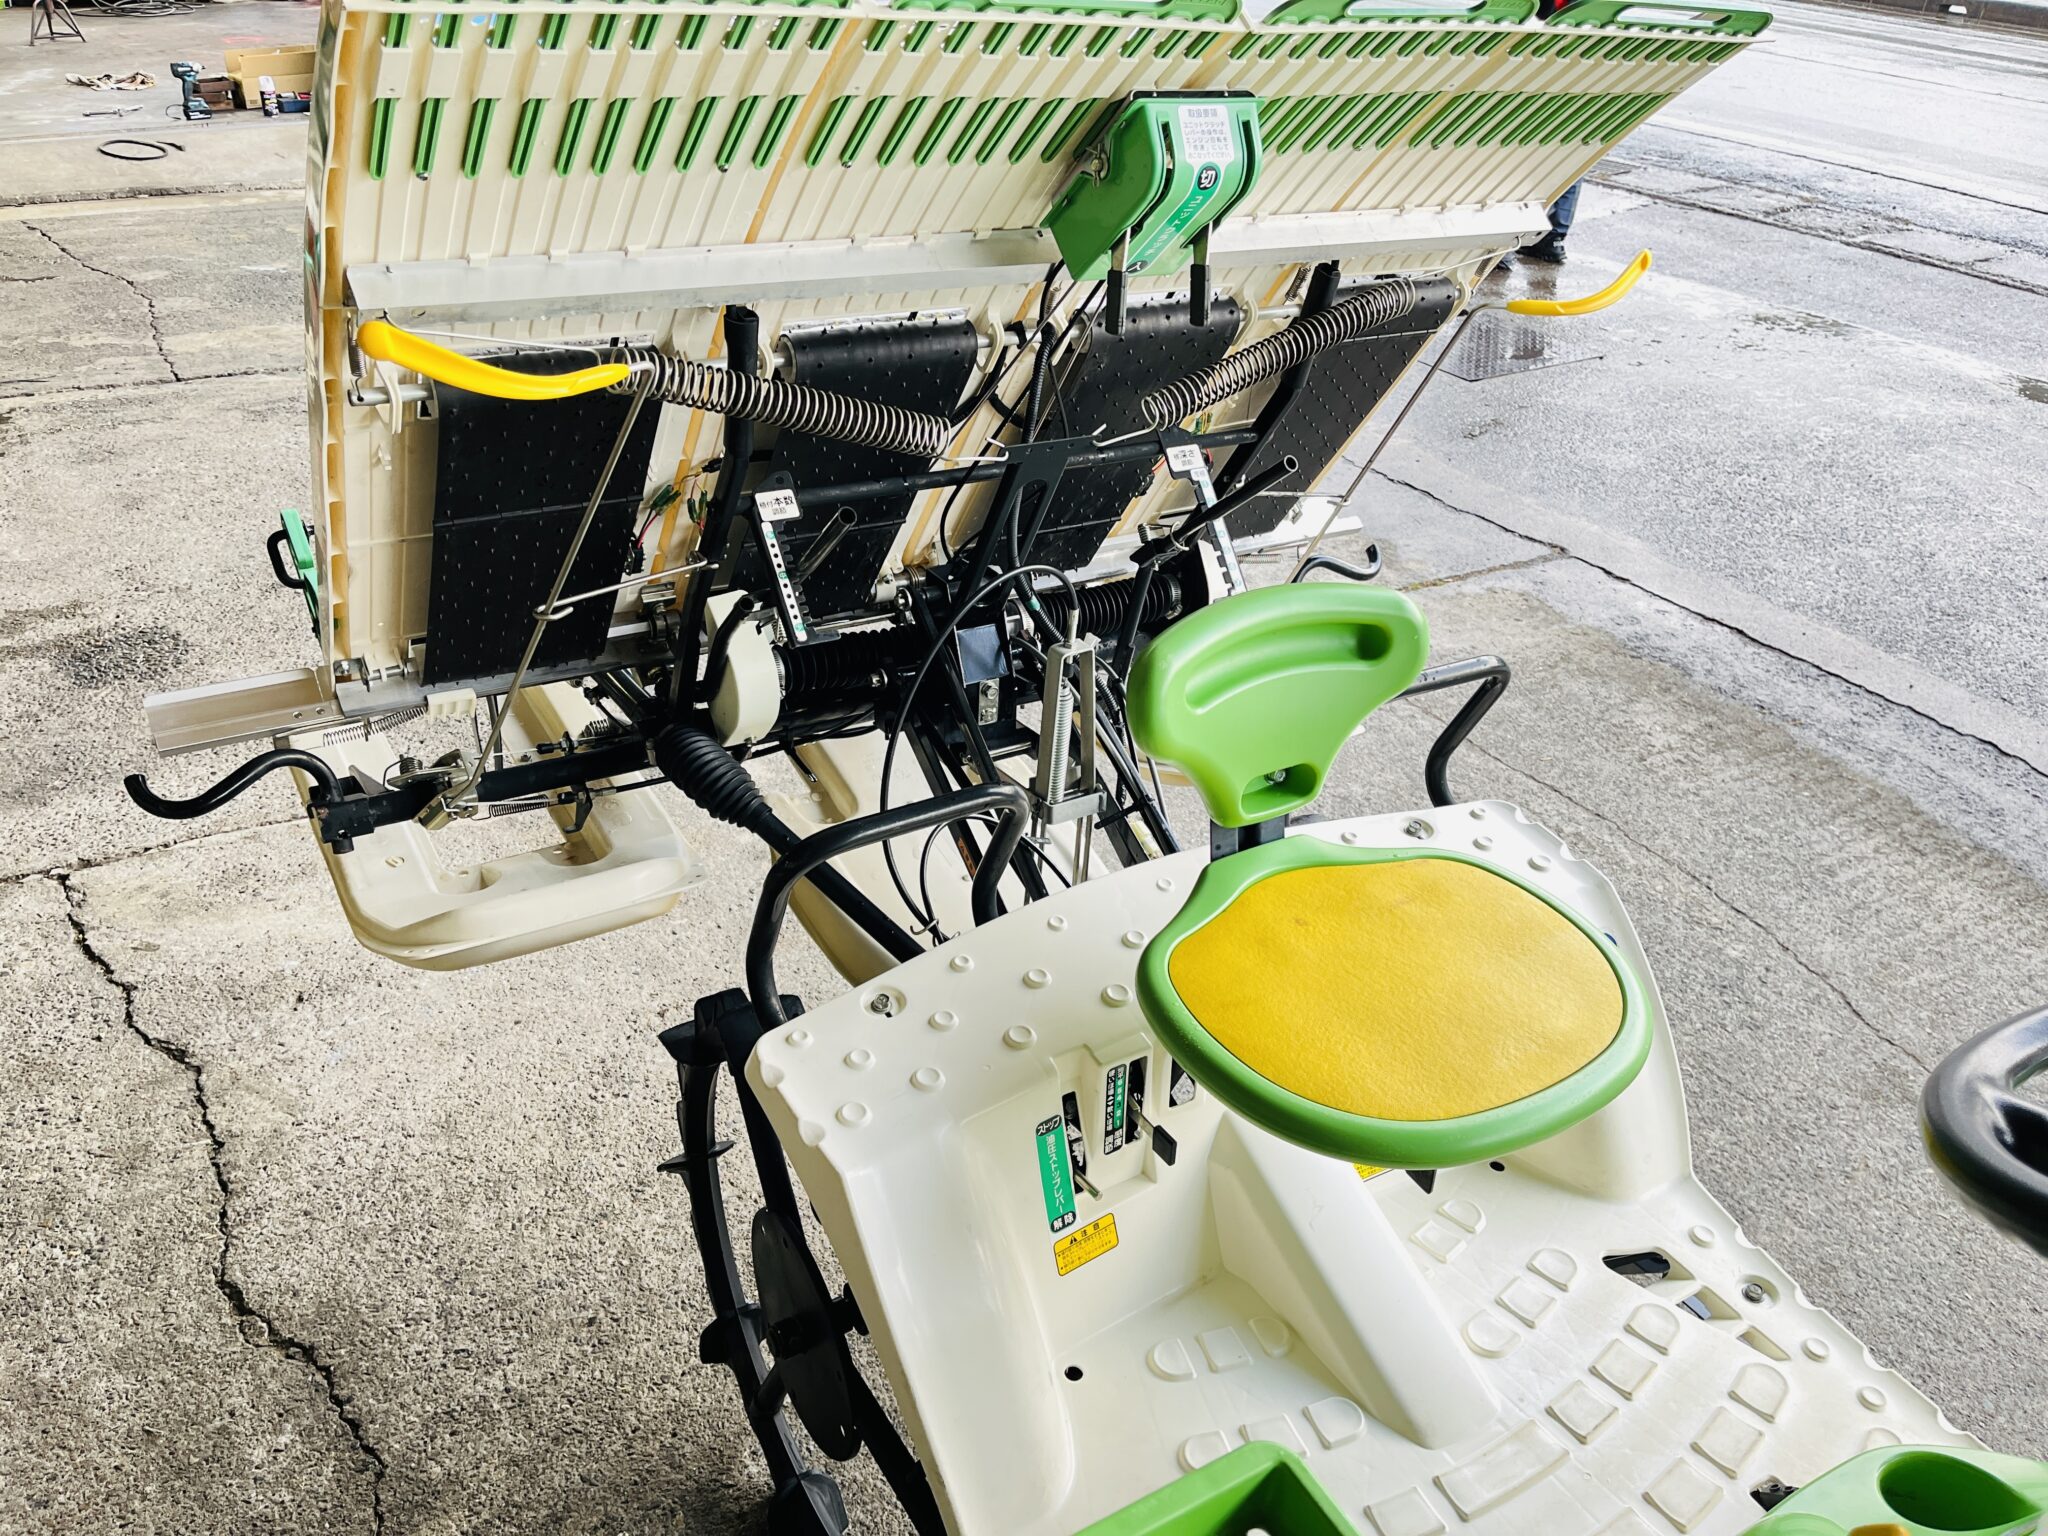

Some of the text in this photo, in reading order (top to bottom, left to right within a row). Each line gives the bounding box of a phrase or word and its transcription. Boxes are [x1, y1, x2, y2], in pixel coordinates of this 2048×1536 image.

[1200, 169, 1216, 188] 切
[1037, 1116, 1061, 1136] ストップ
[1045, 1134, 1066, 1214] 油圧ストップレバー
[1052, 1211, 1074, 1231] 解除
